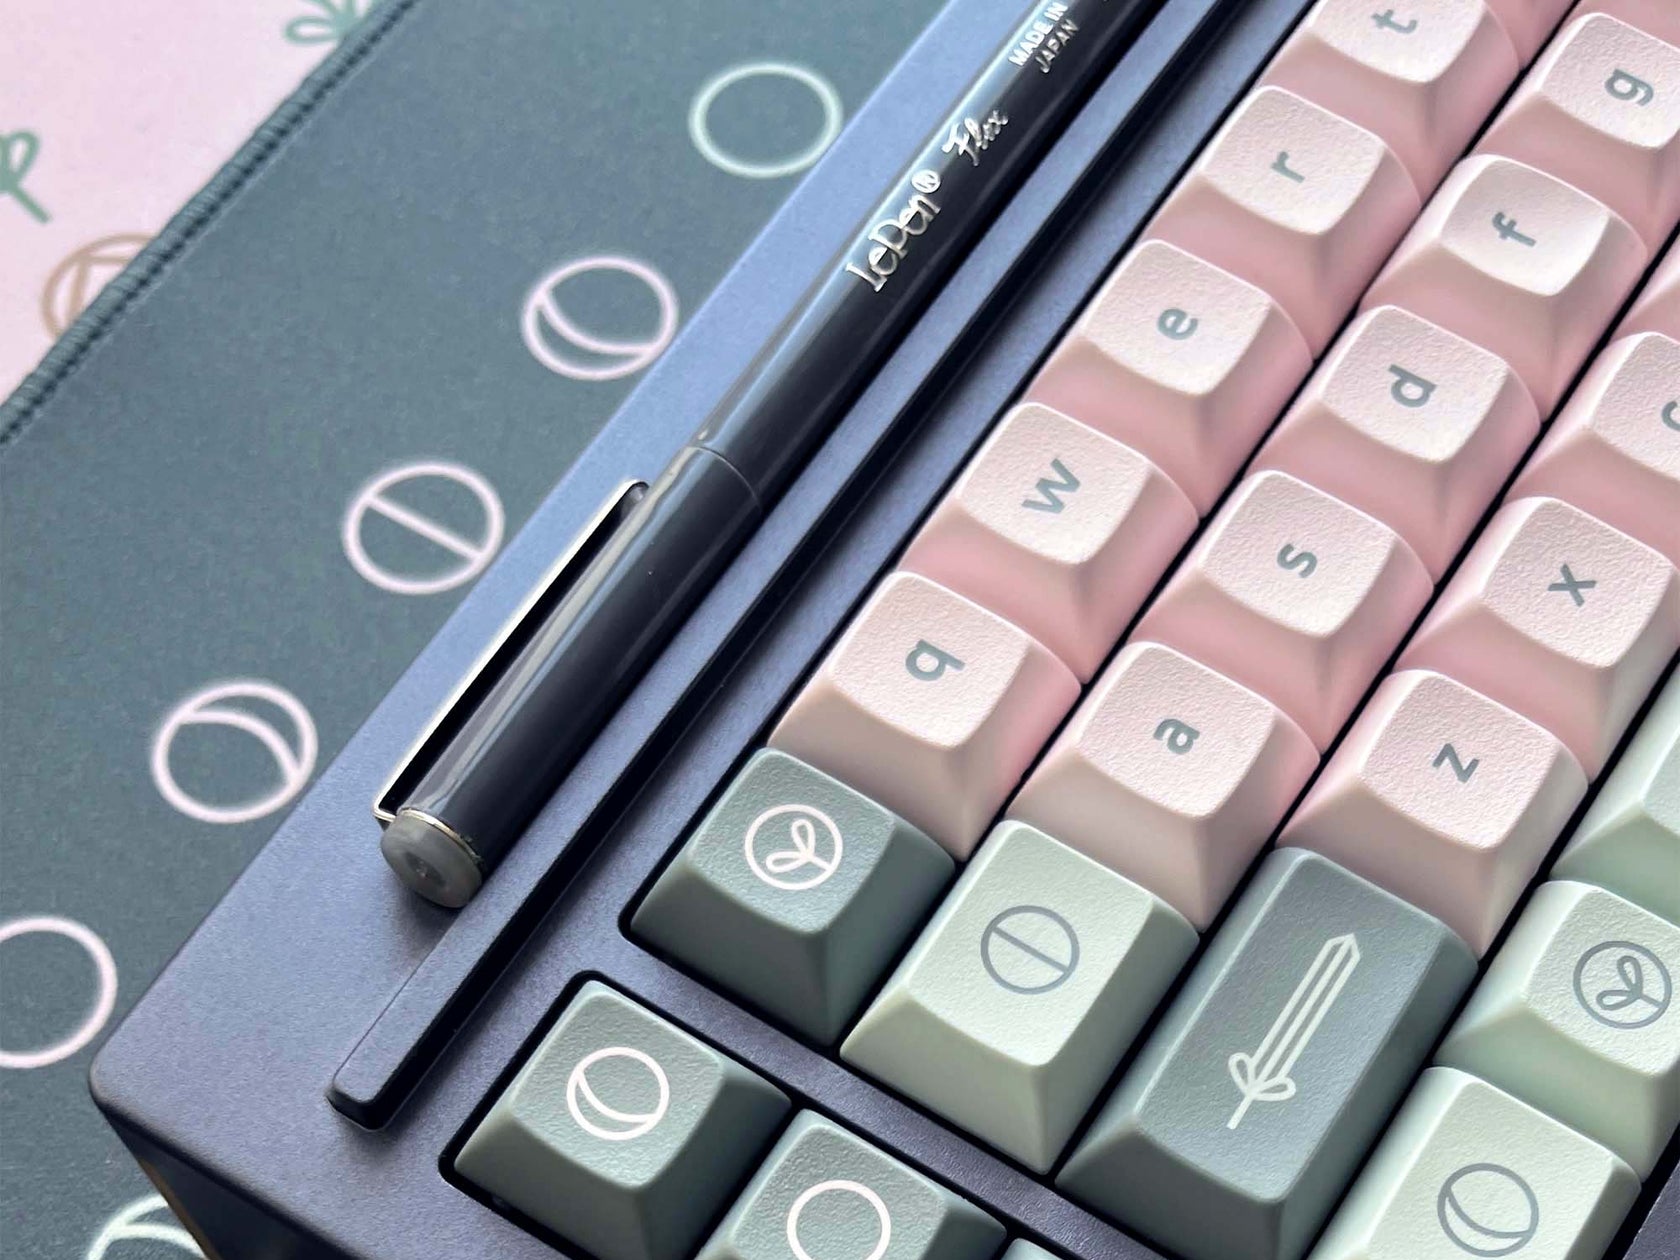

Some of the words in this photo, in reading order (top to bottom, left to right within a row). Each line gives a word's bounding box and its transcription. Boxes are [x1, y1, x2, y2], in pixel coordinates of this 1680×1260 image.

[1008, 21, 1054, 67] MADE
[1043, 1, 1068, 21] IN
[1371, 8, 1418, 35] t
[1035, 18, 1079, 74] JAPAN
[1604, 68, 1655, 107] g
[942, 109, 1009, 167] Flex
[1270, 150, 1306, 184] r
[1491, 211, 1537, 248] f
[1156, 307, 1199, 341] e
[1387, 364, 1437, 408] d
[1276, 543, 1318, 579] s
[1547, 562, 1598, 607] x
[904, 638, 966, 682] q
[1153, 717, 1201, 756] a
